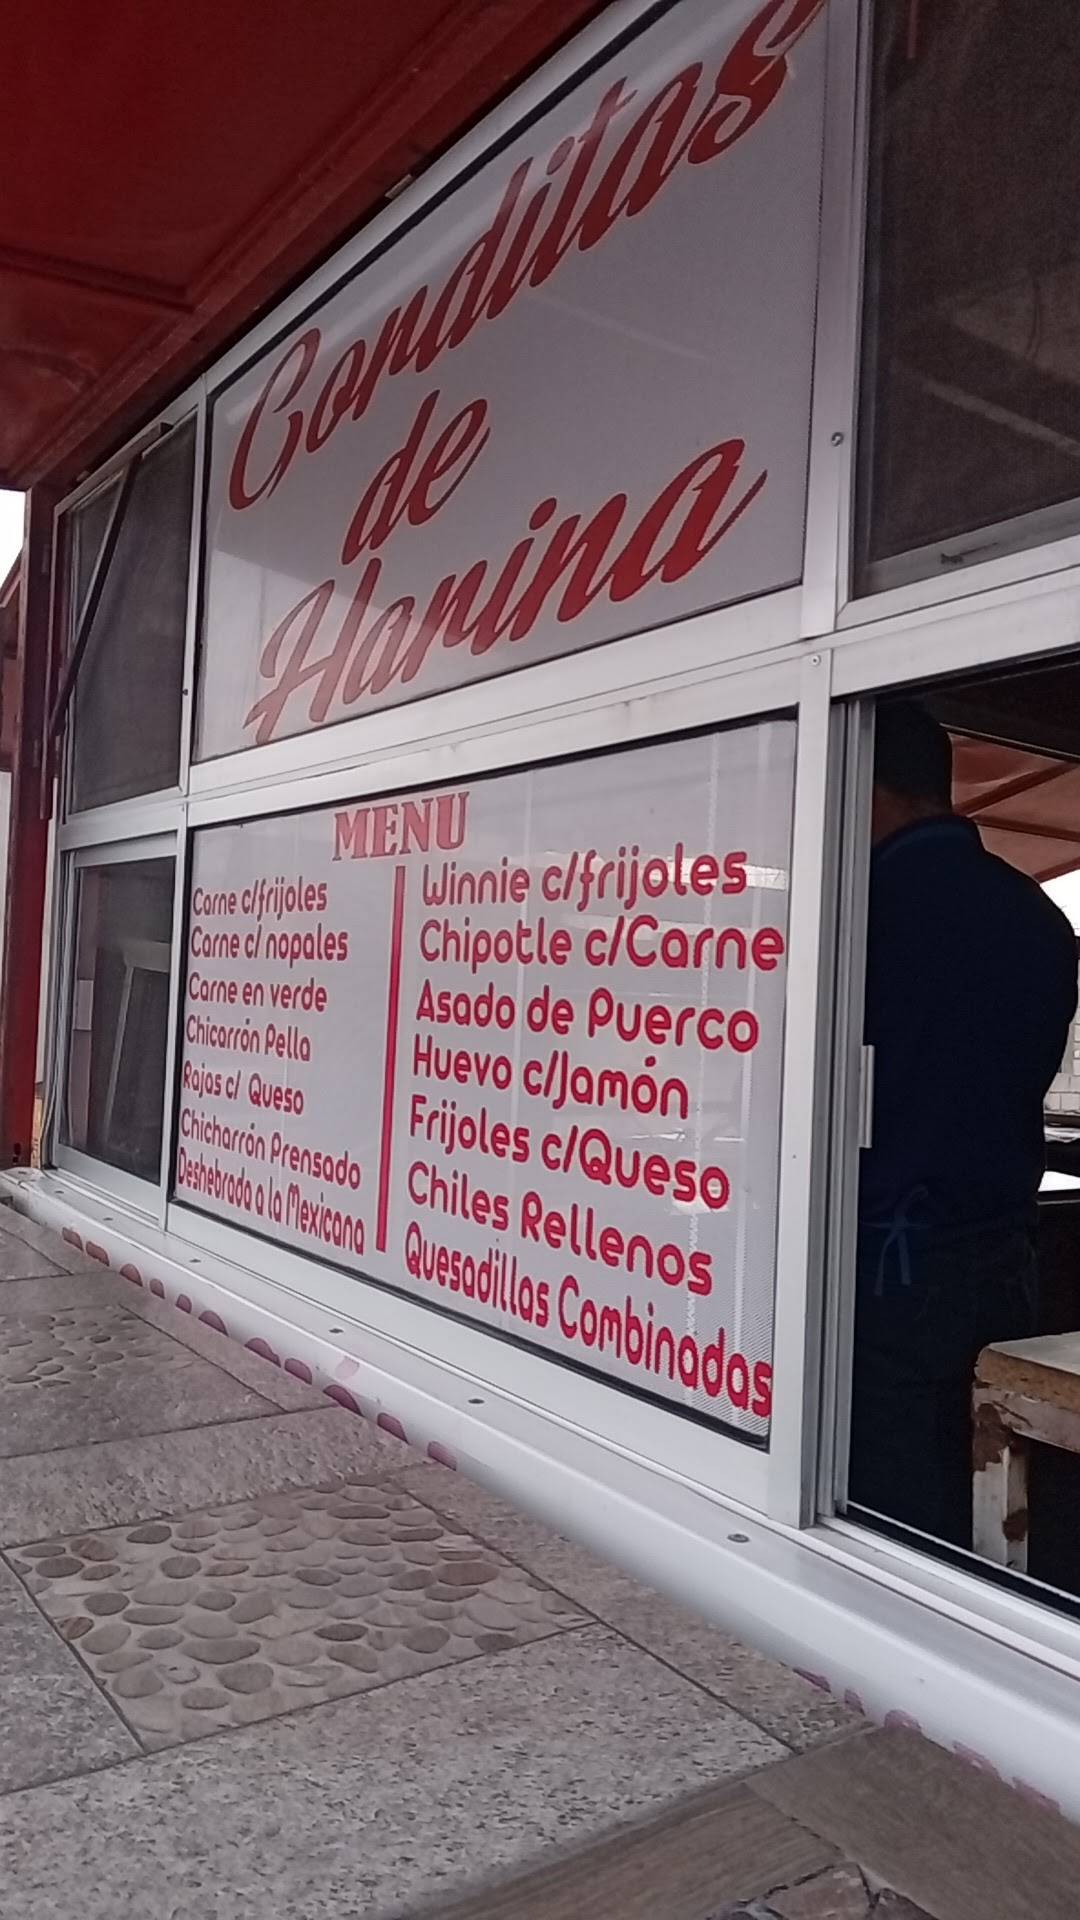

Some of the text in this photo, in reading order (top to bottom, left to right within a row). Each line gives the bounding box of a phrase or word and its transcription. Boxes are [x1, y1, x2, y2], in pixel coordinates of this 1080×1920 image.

[341, 389, 491, 566] de
[242, 438, 768, 746] Harina
[332, 791, 470, 861] MENU
[192, 875, 328, 922] Carne c/frijoles
[421, 842, 748, 912] Winnie c/frijoles
[190, 922, 349, 969] Carne c/ nopales
[419, 914, 786, 974] Chipotle c/Carne
[188, 971, 328, 1013] Carne en verde
[415, 978, 761, 1055] Asado de Puerco
[264, 1022, 312, 1062] Pella
[412, 1034, 513, 1092] Huevo
[182, 1059, 305, 1115] Rajas c/ Queso
[269, 1131, 361, 1190] Prensado
[408, 1093, 732, 1211] Frijoles c/Queso
[177, 1146, 366, 1256] Deshebrada a la Mexicana
[406, 1160, 715, 1298] Chiles Rellenos
[404, 1221, 551, 1329] Quesadillas
[557, 1275, 775, 1419] Combinadas
